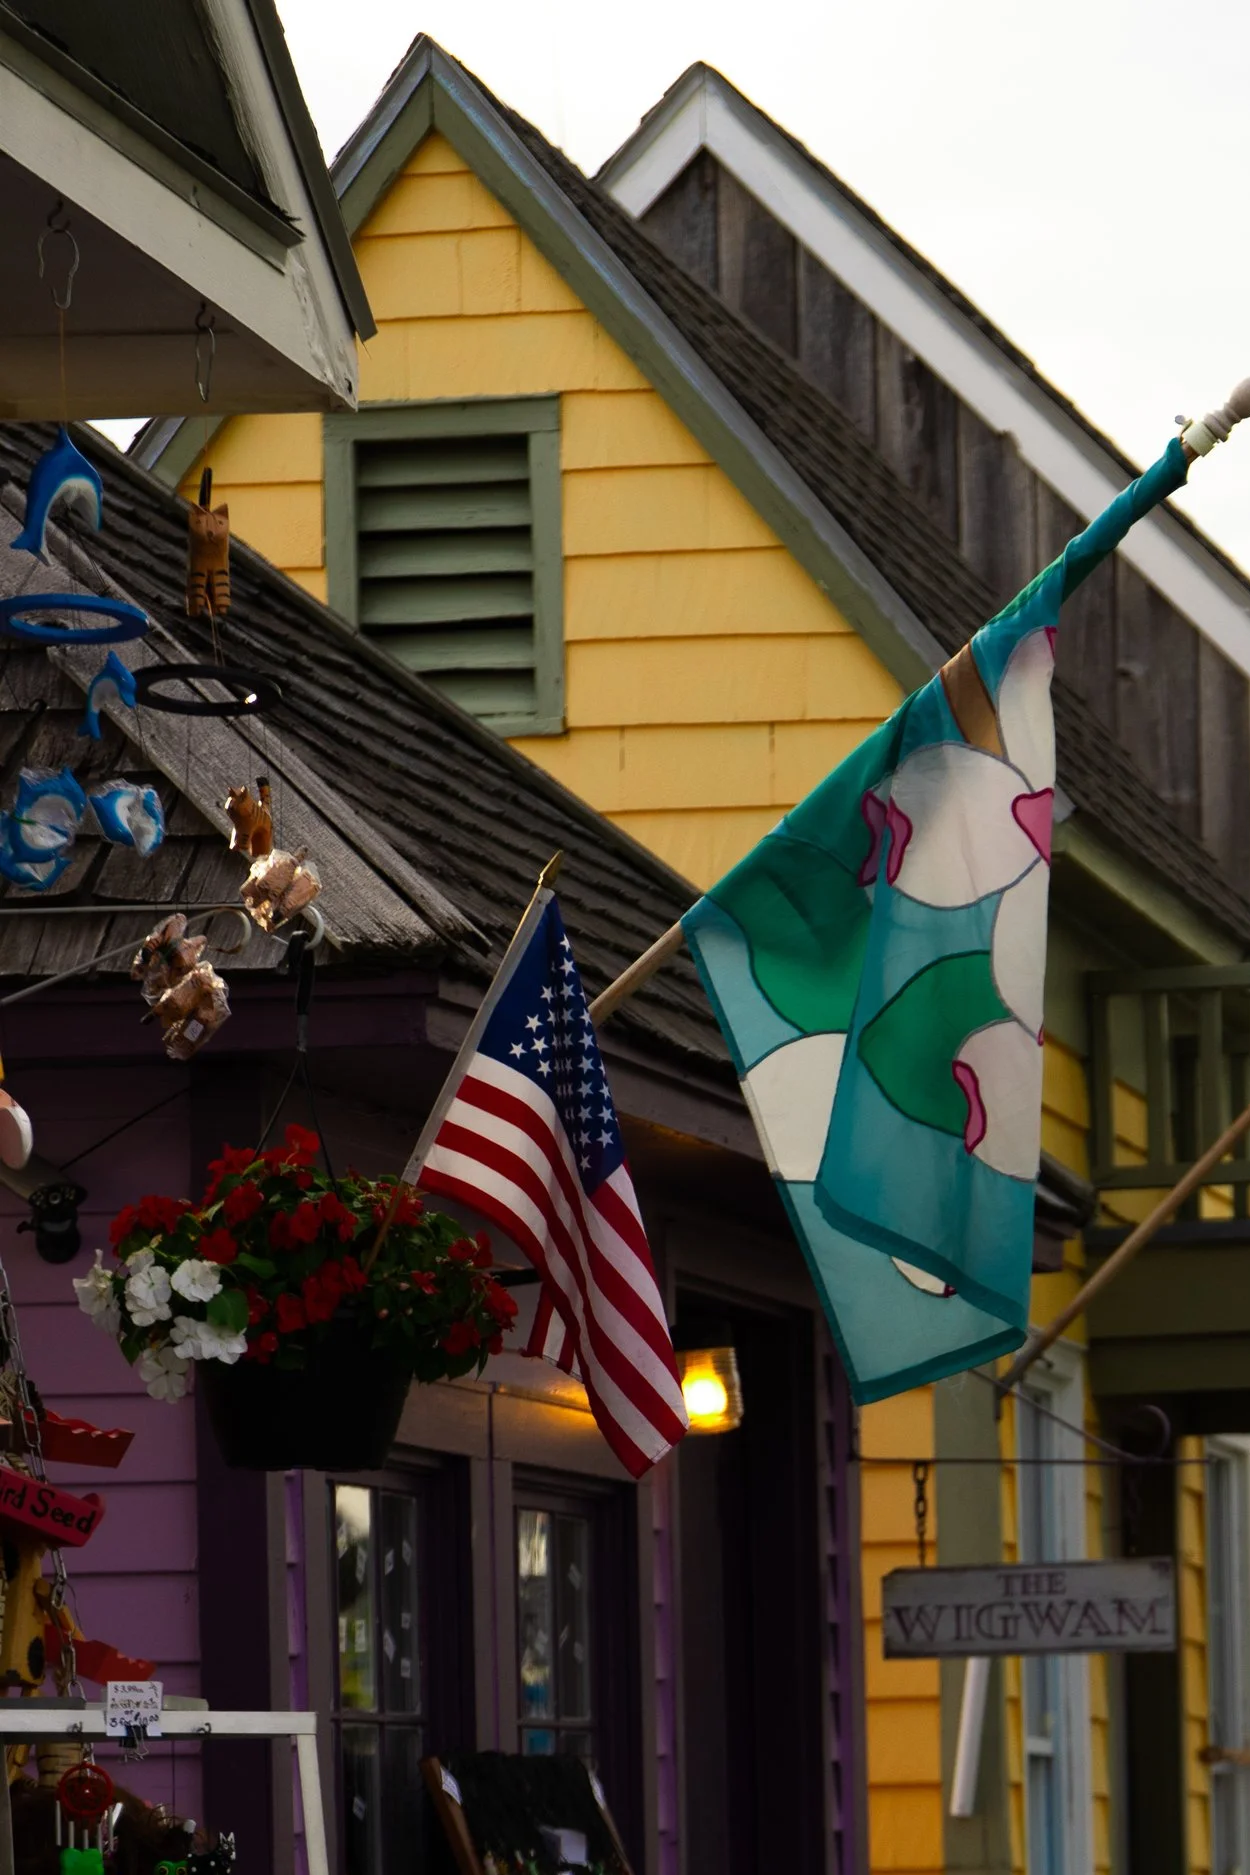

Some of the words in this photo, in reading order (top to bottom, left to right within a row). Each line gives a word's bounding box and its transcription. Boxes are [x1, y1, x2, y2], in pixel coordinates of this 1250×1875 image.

[30, 1488, 97, 1534] Seed
[997, 1572, 1066, 1596] THE
[890, 1599, 1168, 1643] WIGWAM
